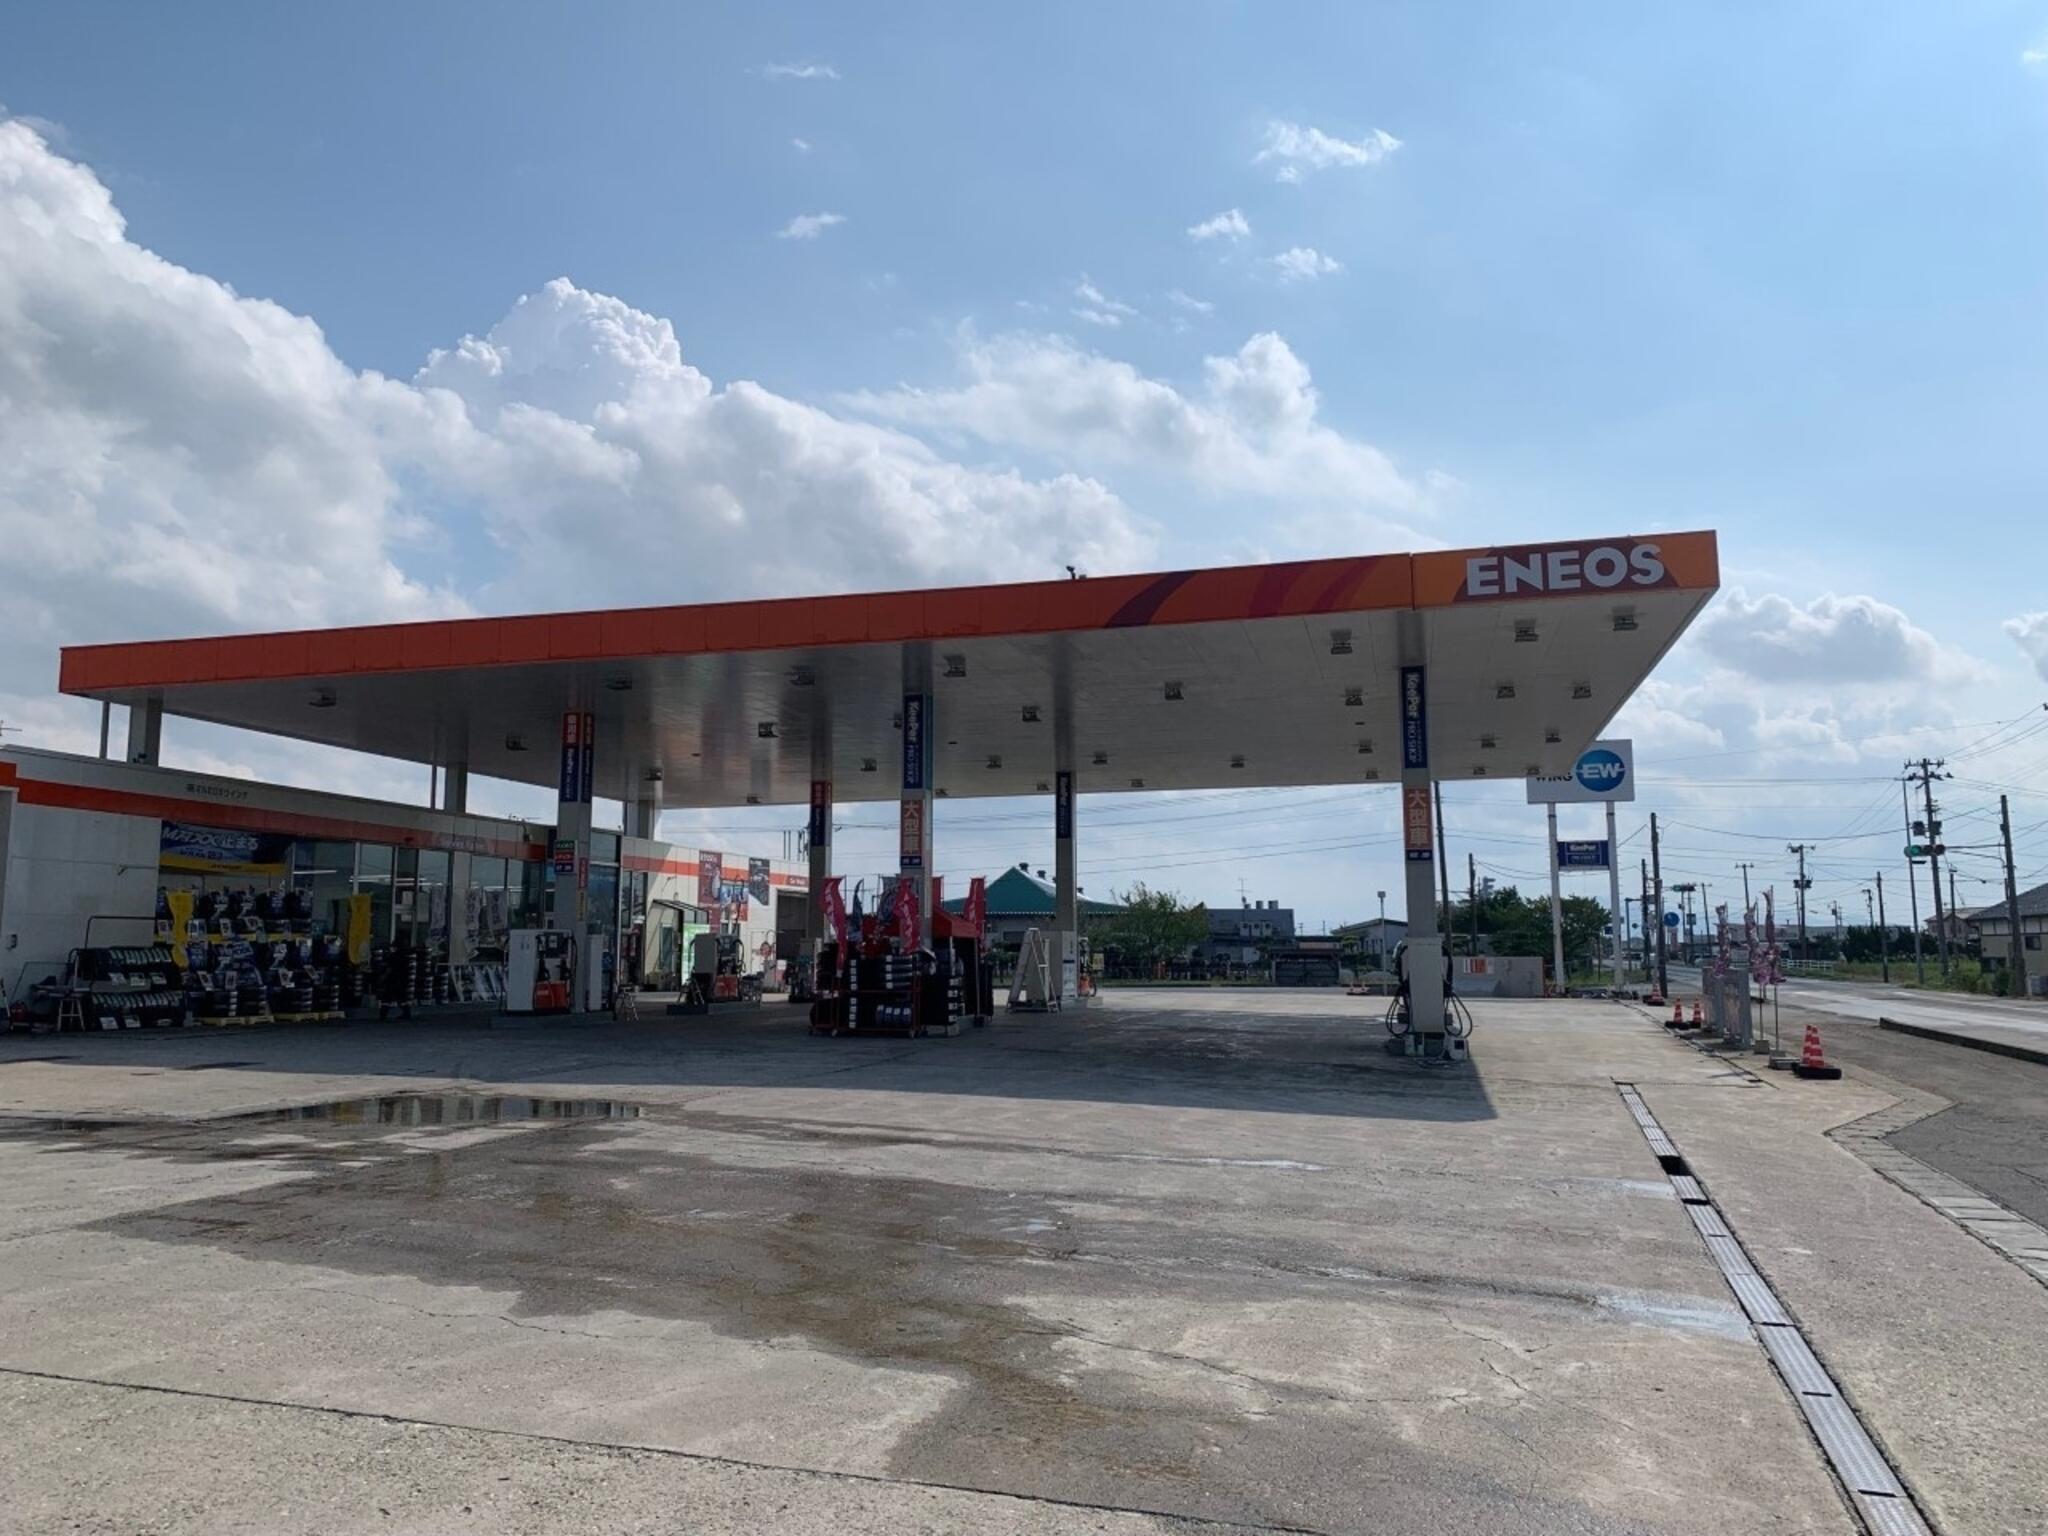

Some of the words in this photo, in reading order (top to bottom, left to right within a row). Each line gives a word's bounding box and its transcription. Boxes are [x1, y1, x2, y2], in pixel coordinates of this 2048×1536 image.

[1467, 543, 1665, 596] ENEOS
[1408, 674, 1421, 718] KeePer
[907, 700, 920, 742] KeePer
[1582, 763, 1621, 780] EW
[903, 800, 920, 854] 大型車
[1409, 790, 1429, 847] 大型車
